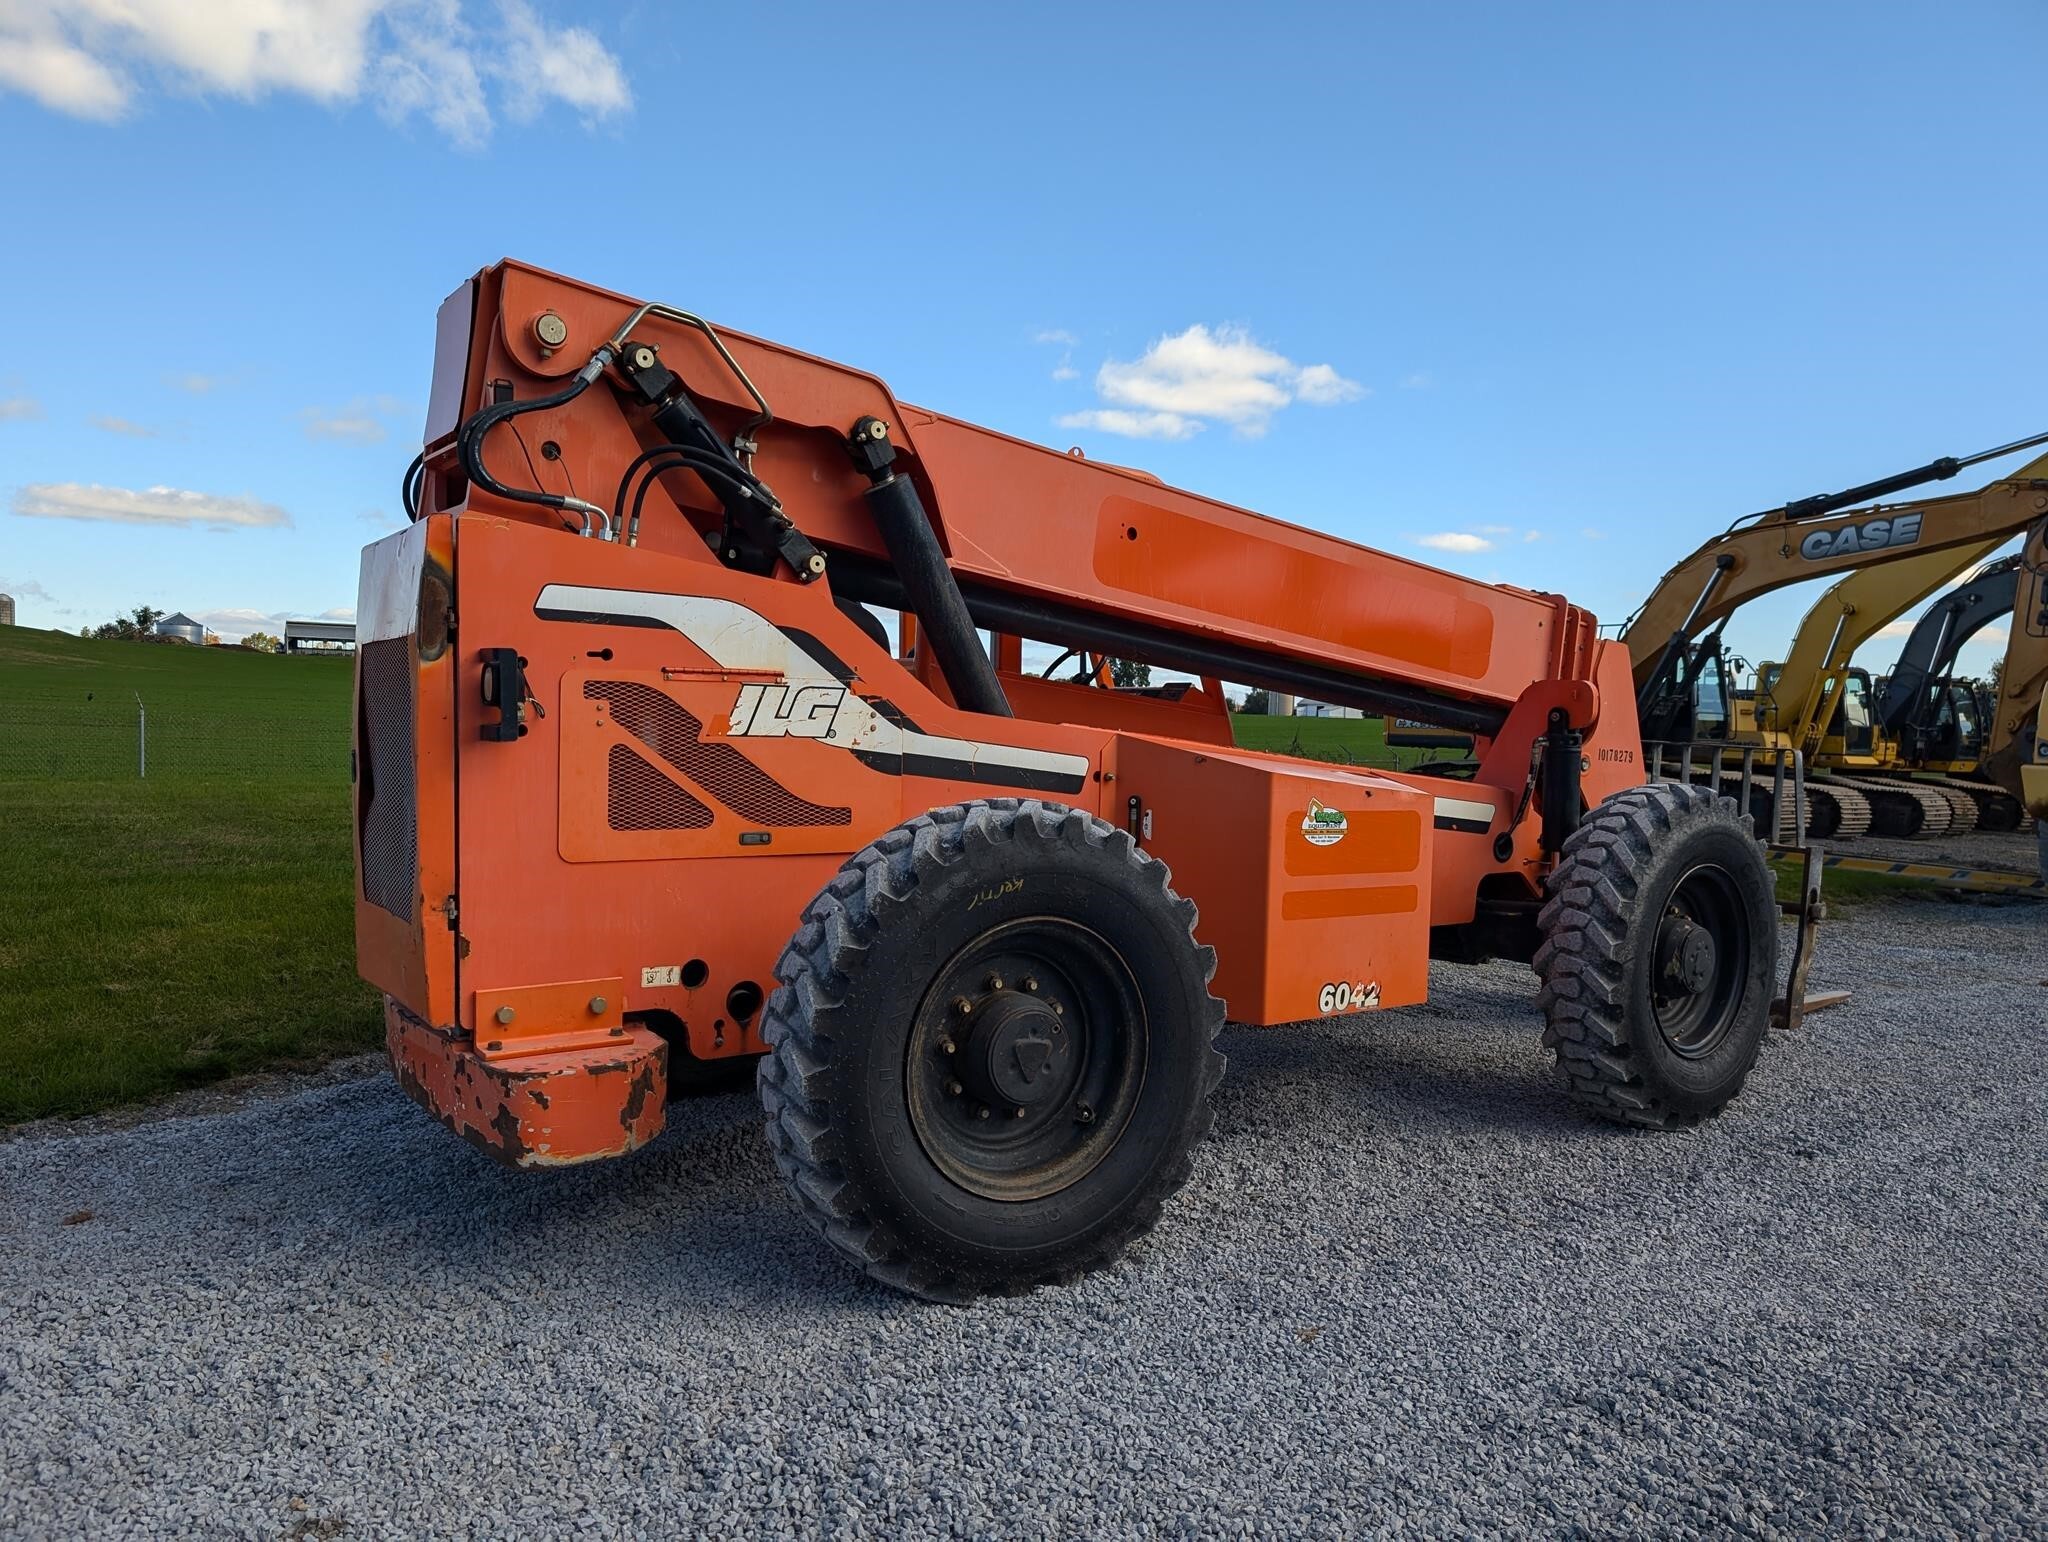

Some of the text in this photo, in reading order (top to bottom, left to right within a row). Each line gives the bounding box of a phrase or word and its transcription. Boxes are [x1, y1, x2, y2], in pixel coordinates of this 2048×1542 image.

[1801, 512, 1923, 560] CASE
[1598, 747, 1634, 763] 10178279
[1318, 981, 1381, 1013] 6042
